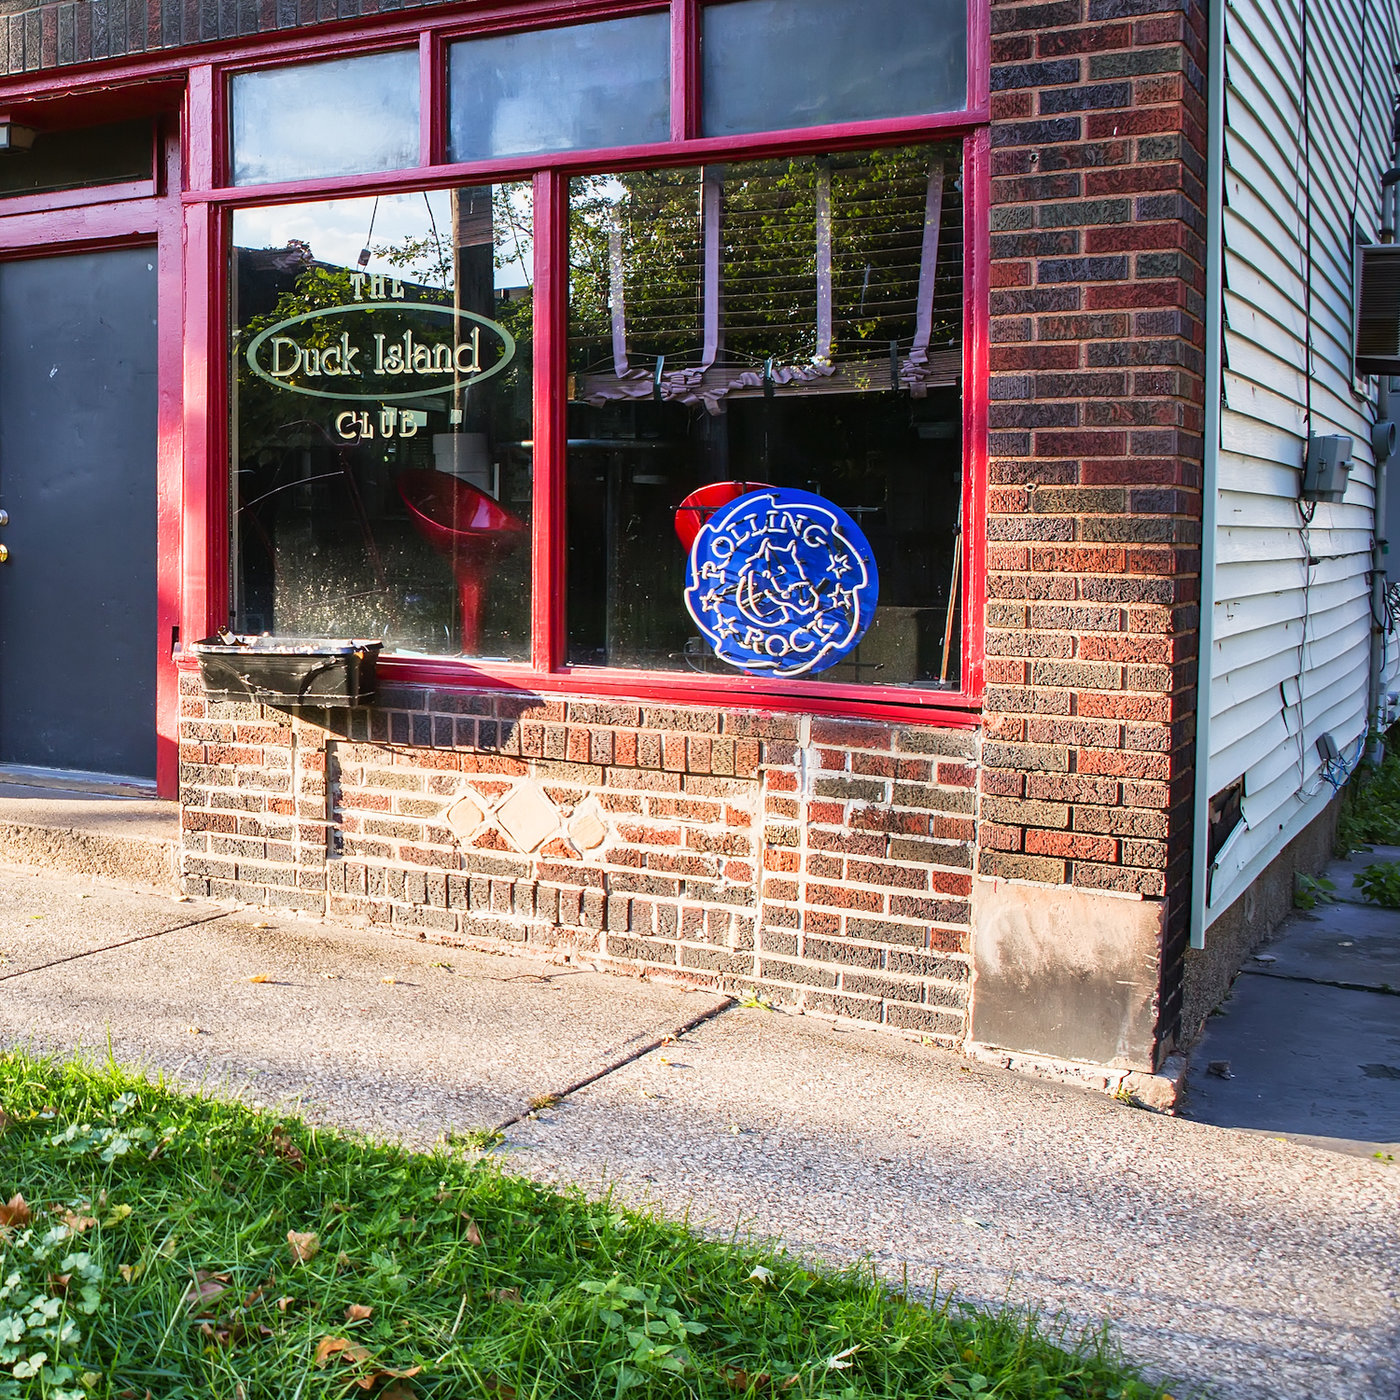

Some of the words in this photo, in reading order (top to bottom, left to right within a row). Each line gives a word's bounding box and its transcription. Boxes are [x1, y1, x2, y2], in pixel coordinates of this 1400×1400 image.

[350, 272, 405, 301] THE
[269, 331, 362, 377] Duck
[373, 326, 482, 375] Island
[335, 410, 419, 440] CLUB
[700, 509, 829, 584] ROLLING
[738, 611, 840, 657] ROCK
